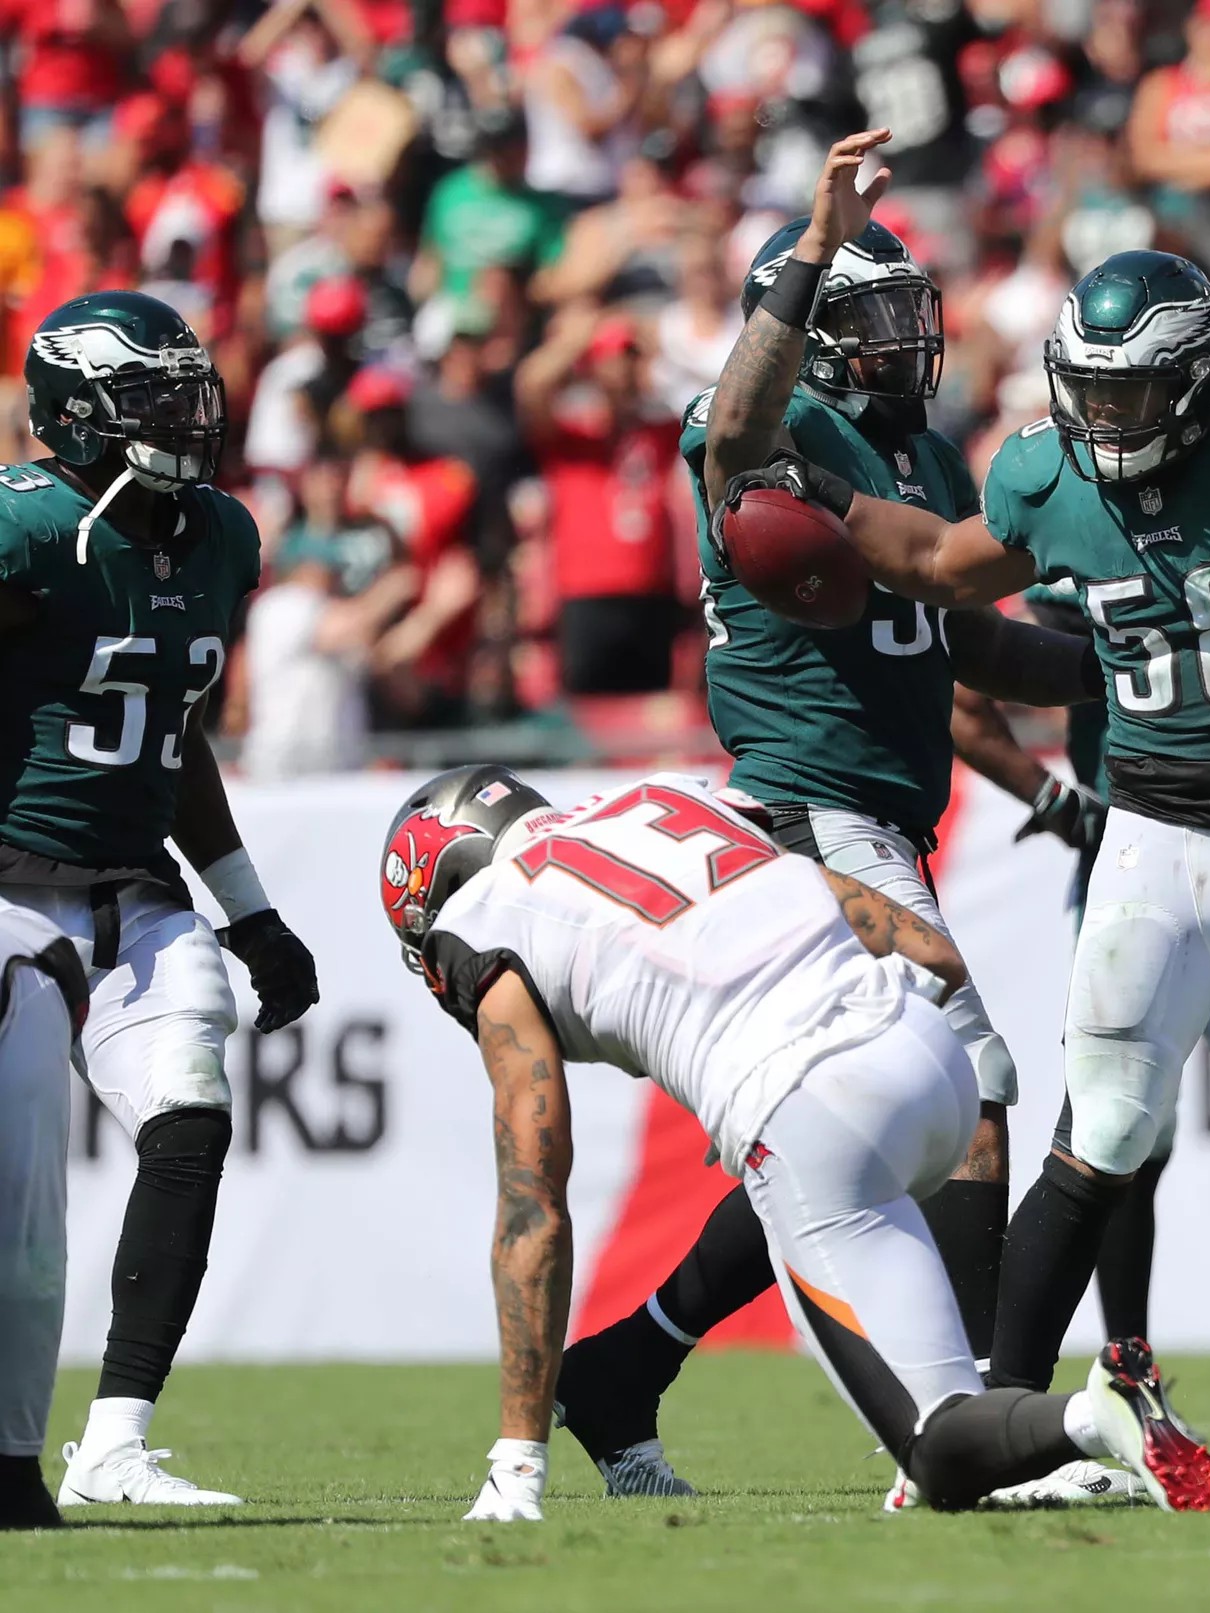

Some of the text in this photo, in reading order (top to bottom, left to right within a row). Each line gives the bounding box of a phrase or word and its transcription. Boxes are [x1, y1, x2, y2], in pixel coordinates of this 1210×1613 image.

[1130, 526, 1183, 551] EAGLES
[149, 594, 186, 611] EAGLES
[66, 634, 226, 770] 53
[511, 784, 783, 930] 13
